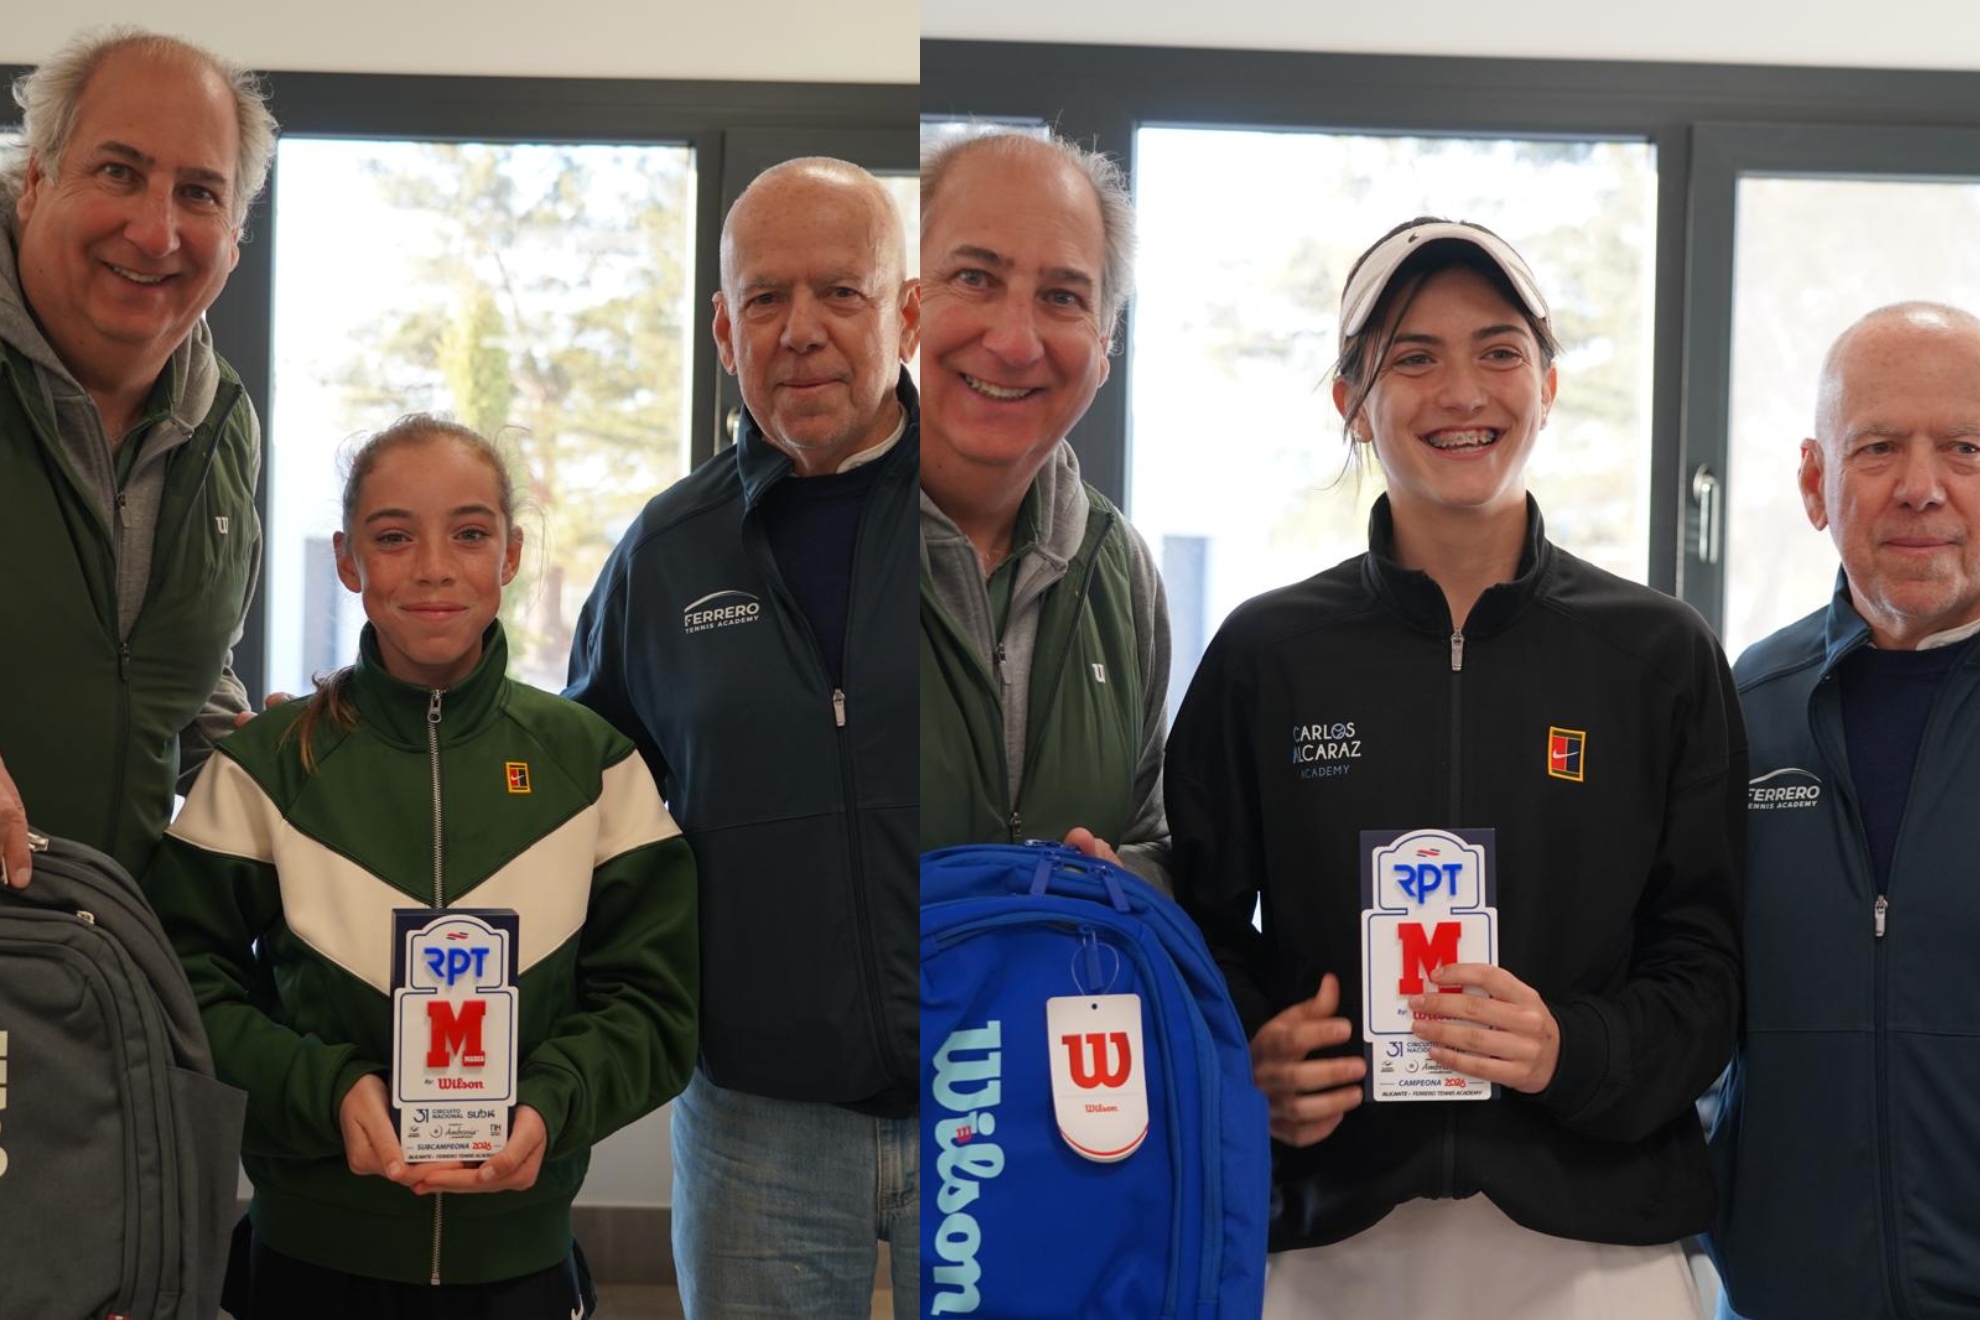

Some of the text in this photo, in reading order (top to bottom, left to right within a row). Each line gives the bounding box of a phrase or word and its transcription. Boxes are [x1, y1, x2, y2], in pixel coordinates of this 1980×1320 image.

[684, 602, 760, 628] FERRERO
[685, 615, 760, 634] TENNIS ACADEMY
[1292, 721, 1356, 743] CARLOS
[1292, 740, 1362, 764] ALCARAZ
[1747, 800, 1818, 811] ENNIS ACADEMY
[1393, 863, 1463, 905] RPT
[423, 946, 490, 987] RPT
[1396, 921, 1462, 995] M
[426, 1000, 486, 1068] M
[1061, 1031, 1132, 1089] W
[1386, 1041, 1403, 1057] 31
[438, 1077, 485, 1090] Wilson
[1399, 1077, 1466, 1088] CAMPEONA 2026
[413, 1108, 429, 1123] 31
[1084, 1103, 1119, 1113] Wilson
[472, 1141, 492, 1150] 2026
[931, 1020, 1005, 1316] Wilson
